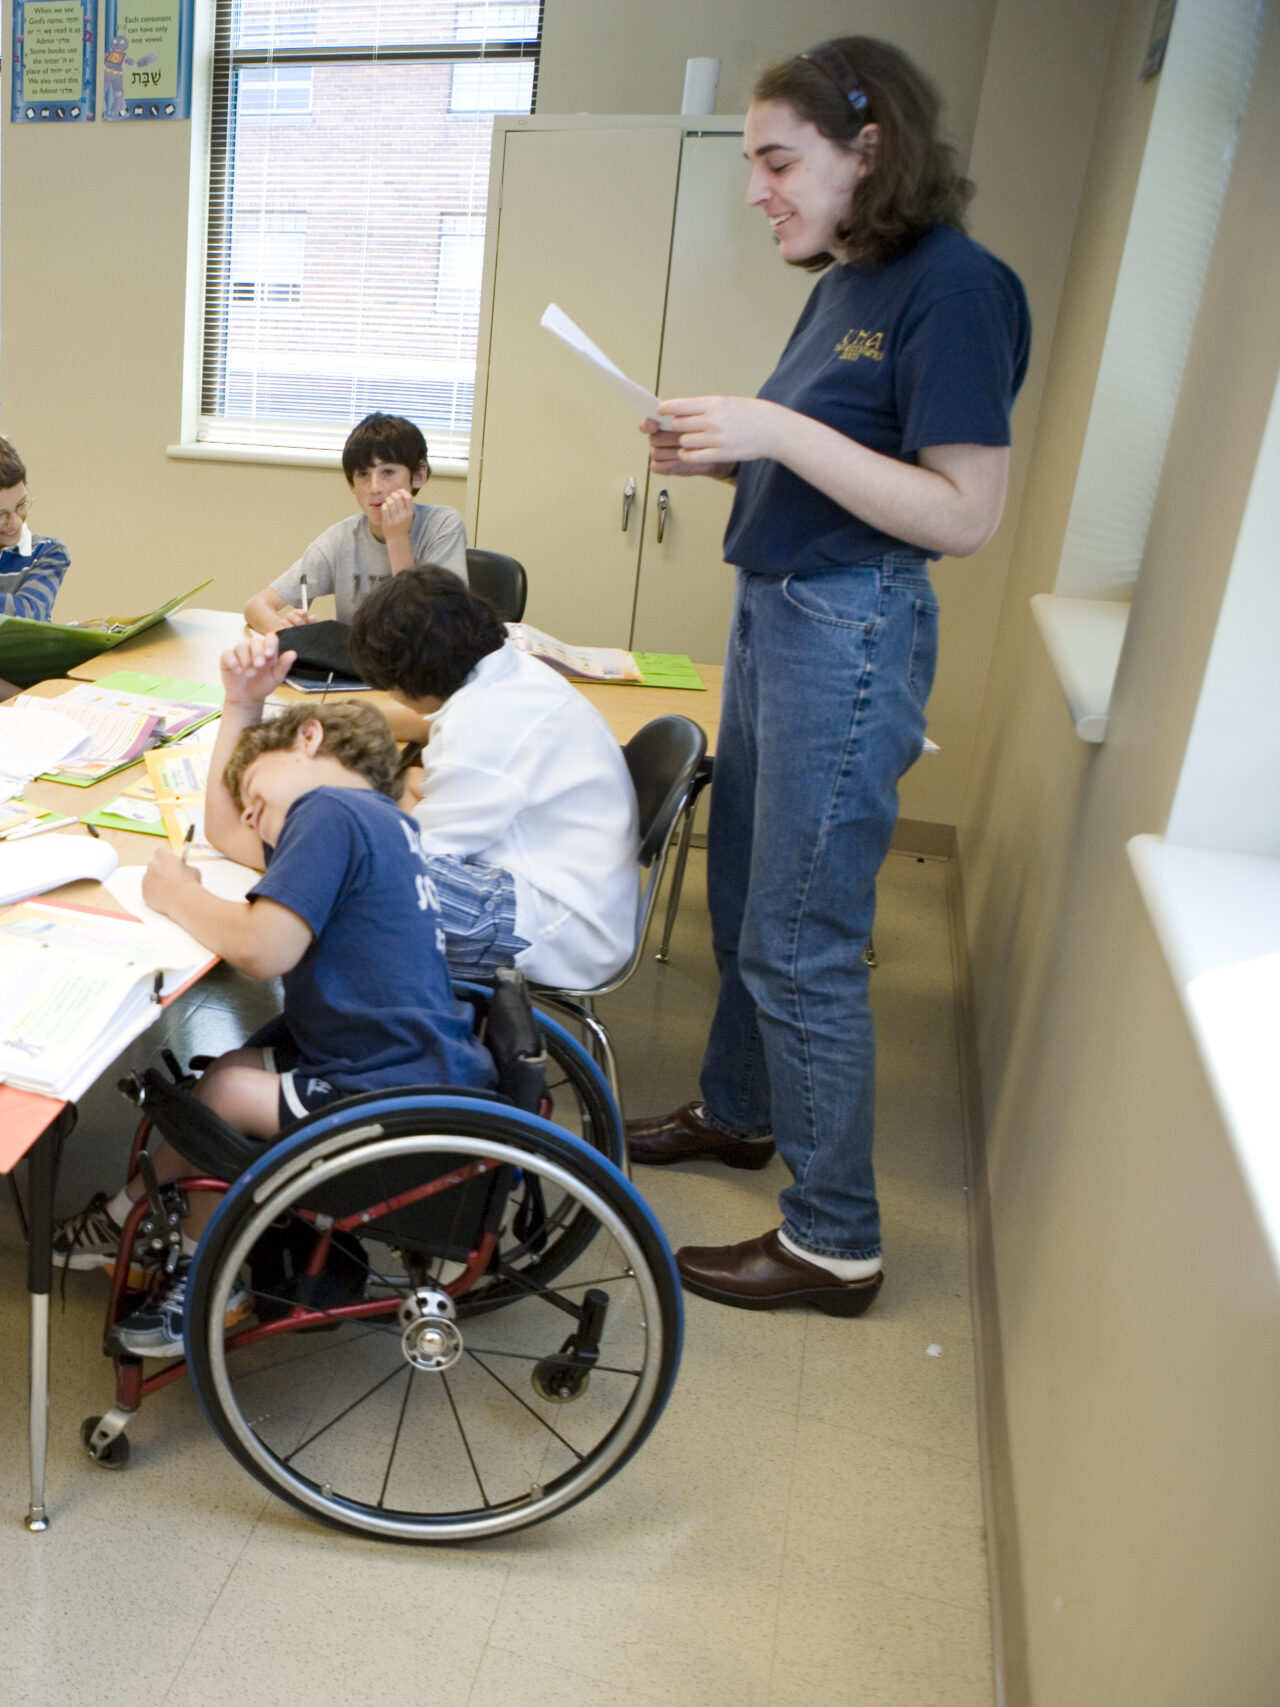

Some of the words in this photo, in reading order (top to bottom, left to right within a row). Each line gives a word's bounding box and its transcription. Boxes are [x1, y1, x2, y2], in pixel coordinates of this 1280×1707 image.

[28, 17, 45, 25] God's
[124, 16, 139, 24] Each
[154, 25, 168, 34] only
